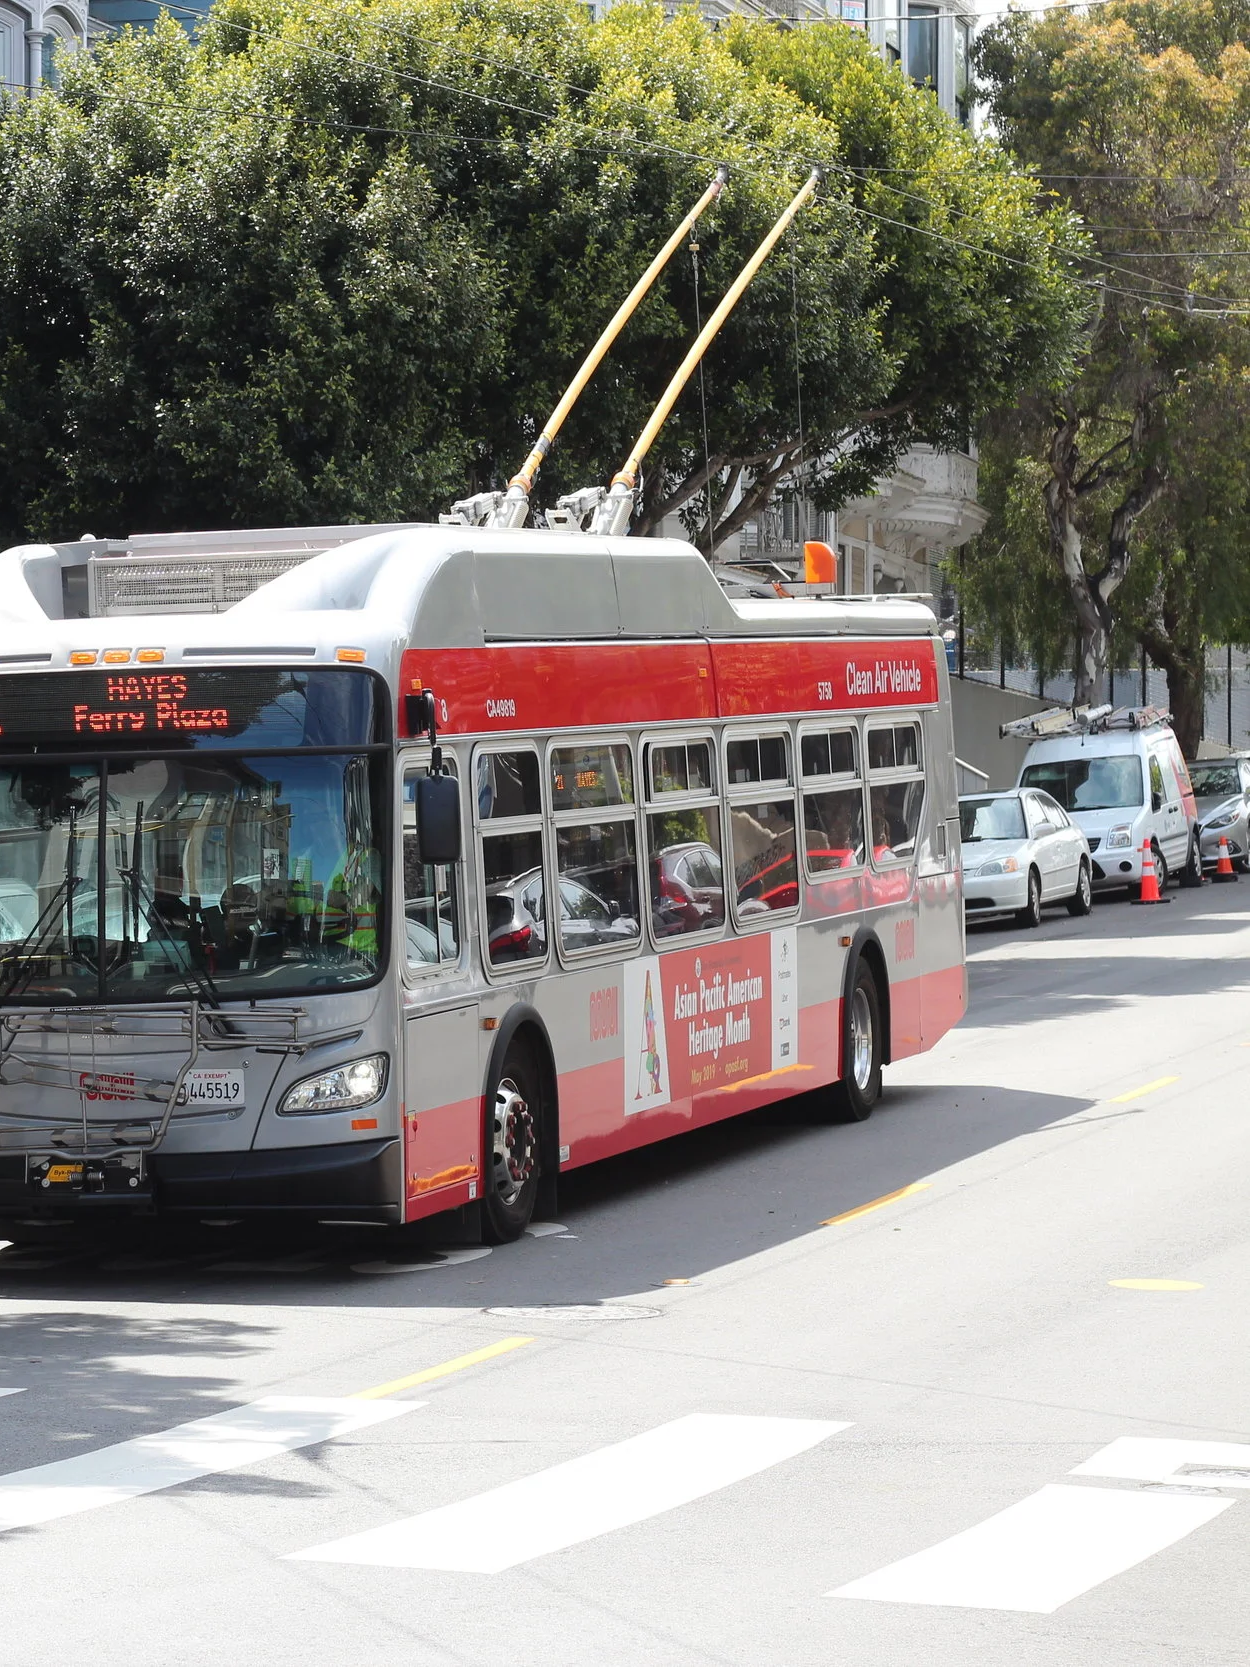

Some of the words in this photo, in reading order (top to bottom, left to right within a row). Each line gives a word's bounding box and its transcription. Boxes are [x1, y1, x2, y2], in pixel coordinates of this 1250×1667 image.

[107, 675, 188, 701] HAYES
[846, 661, 873, 696] Clean
[875, 660, 888, 694] Air
[888, 659, 922, 693] Vehicle
[817, 681, 833, 701] 5758
[73, 704, 146, 733] Ferry
[156, 701, 229, 730] Plaza
[486, 699, 516, 718] CA49819
[674, 983, 698, 1021] Asian
[700, 972, 725, 1014] Pacific
[727, 968, 763, 1007] American
[689, 1018, 723, 1060] Heritage
[725, 1004, 751, 1047] Month
[703, 1063, 716, 1081] 2019
[189, 1082, 240, 1099] 445519
